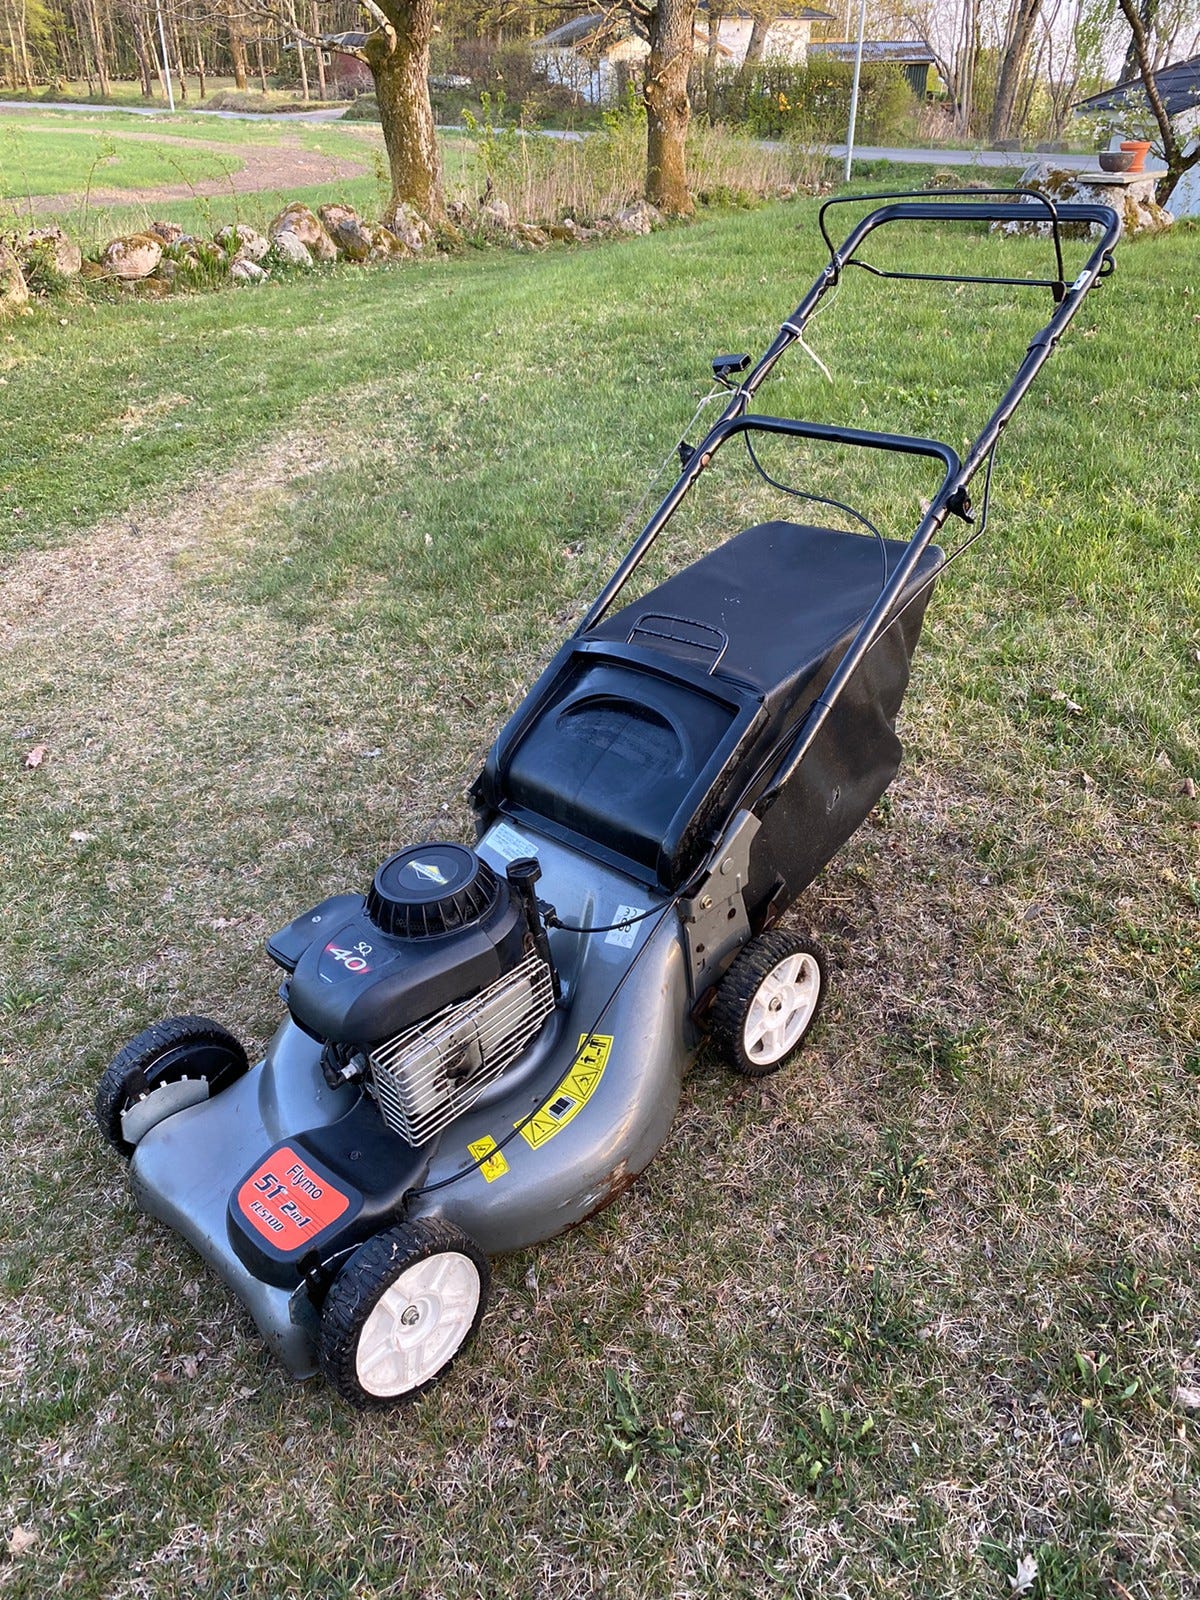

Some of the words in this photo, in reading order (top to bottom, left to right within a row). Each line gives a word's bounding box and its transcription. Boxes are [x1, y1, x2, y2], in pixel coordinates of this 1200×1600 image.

[329, 948, 367, 970] 40
[253, 1173, 287, 1199] 51
[286, 1164, 323, 1200] Flymo
